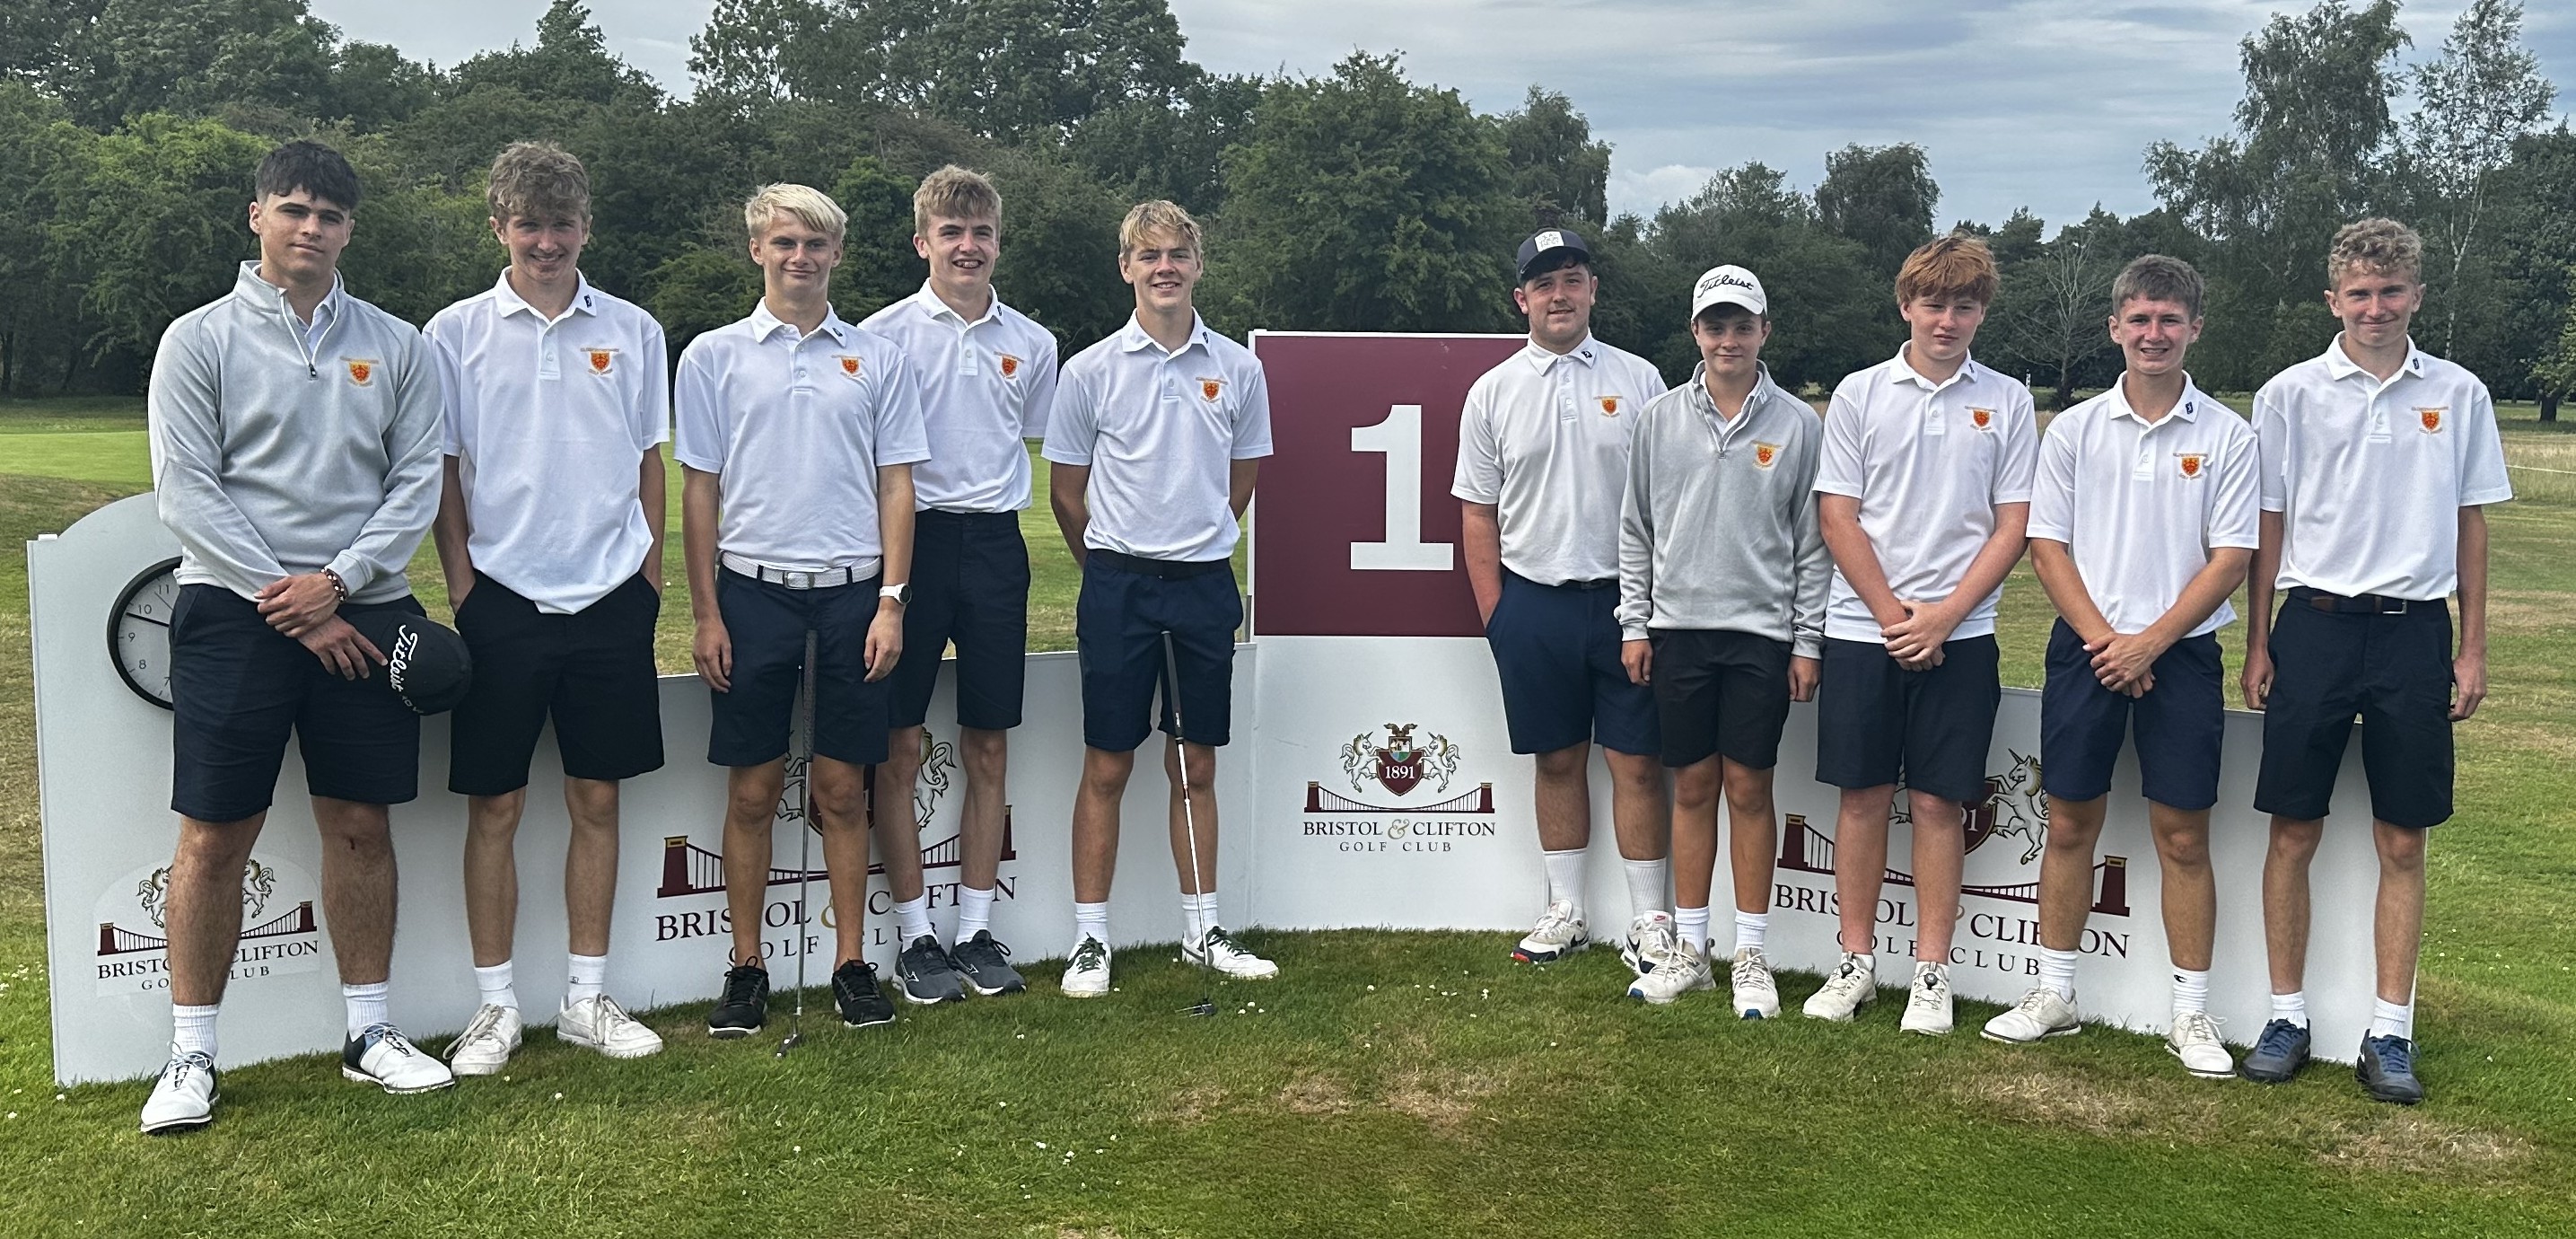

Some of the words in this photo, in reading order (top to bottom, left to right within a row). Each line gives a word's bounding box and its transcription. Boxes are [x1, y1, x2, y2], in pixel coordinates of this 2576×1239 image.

[1697, 274, 1754, 298] Titleist
[1350, 404, 1453, 570] 1
[158, 585, 169, 595] 11
[138, 604, 152, 615] 10
[127, 632, 136, 643] 9
[138, 659, 146, 670] 8
[390, 624, 418, 692] Titleist
[1385, 765, 1415, 779] 1891
[1303, 822, 1383, 836] BRISTOL
[1388, 818, 1410, 839] &
[1413, 821, 1496, 836] CLIFTON
[1339, 841, 1387, 852] GOLF
[1402, 841, 1451, 852] CLUB
[655, 900, 812, 942] BRISOL
[1774, 883, 1914, 927] BRISOL
[1970, 913, 2130, 959] CLIFON
[1950, 946, 2040, 976] CLUB
[230, 966, 270, 980] LUB
